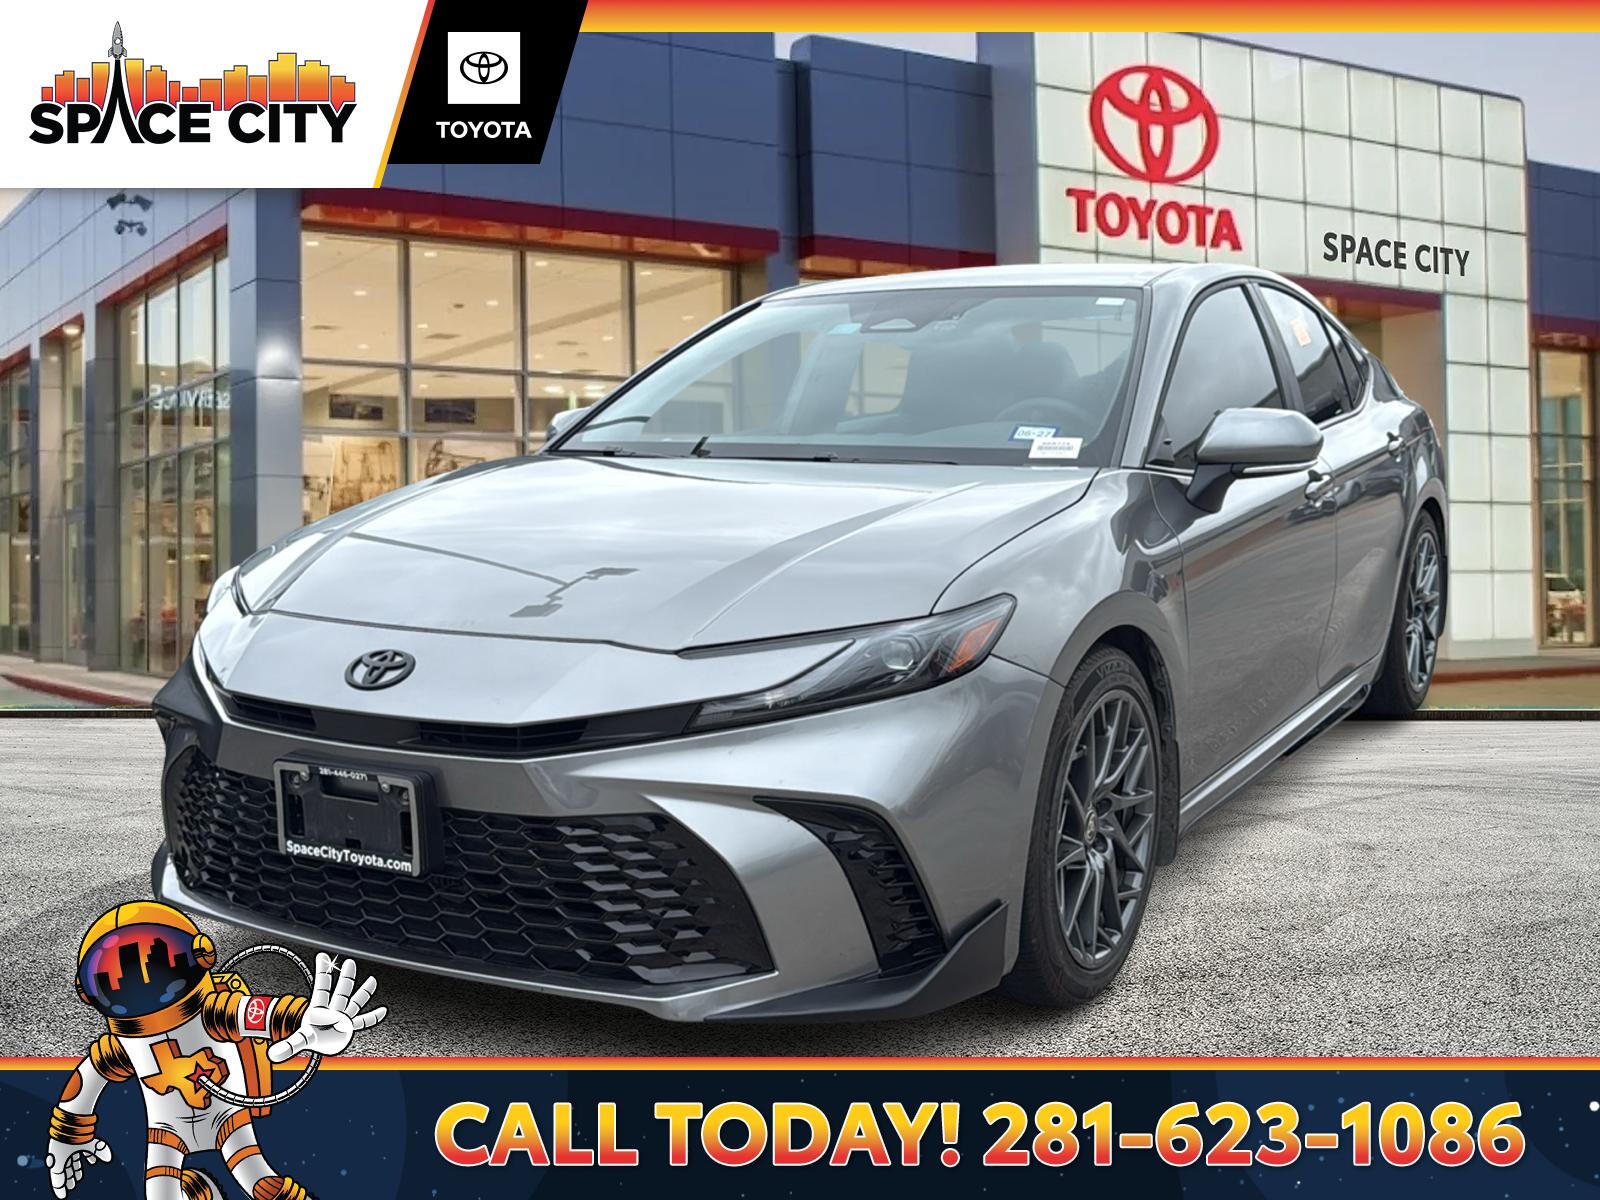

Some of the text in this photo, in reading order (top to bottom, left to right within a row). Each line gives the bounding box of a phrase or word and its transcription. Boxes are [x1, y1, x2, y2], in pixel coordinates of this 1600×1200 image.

[1067, 187, 1243, 252] TOYOTA
[1323, 232, 1470, 277] SPACE CITY
[286, 840, 412, 872] SpaceCityToyota.com
